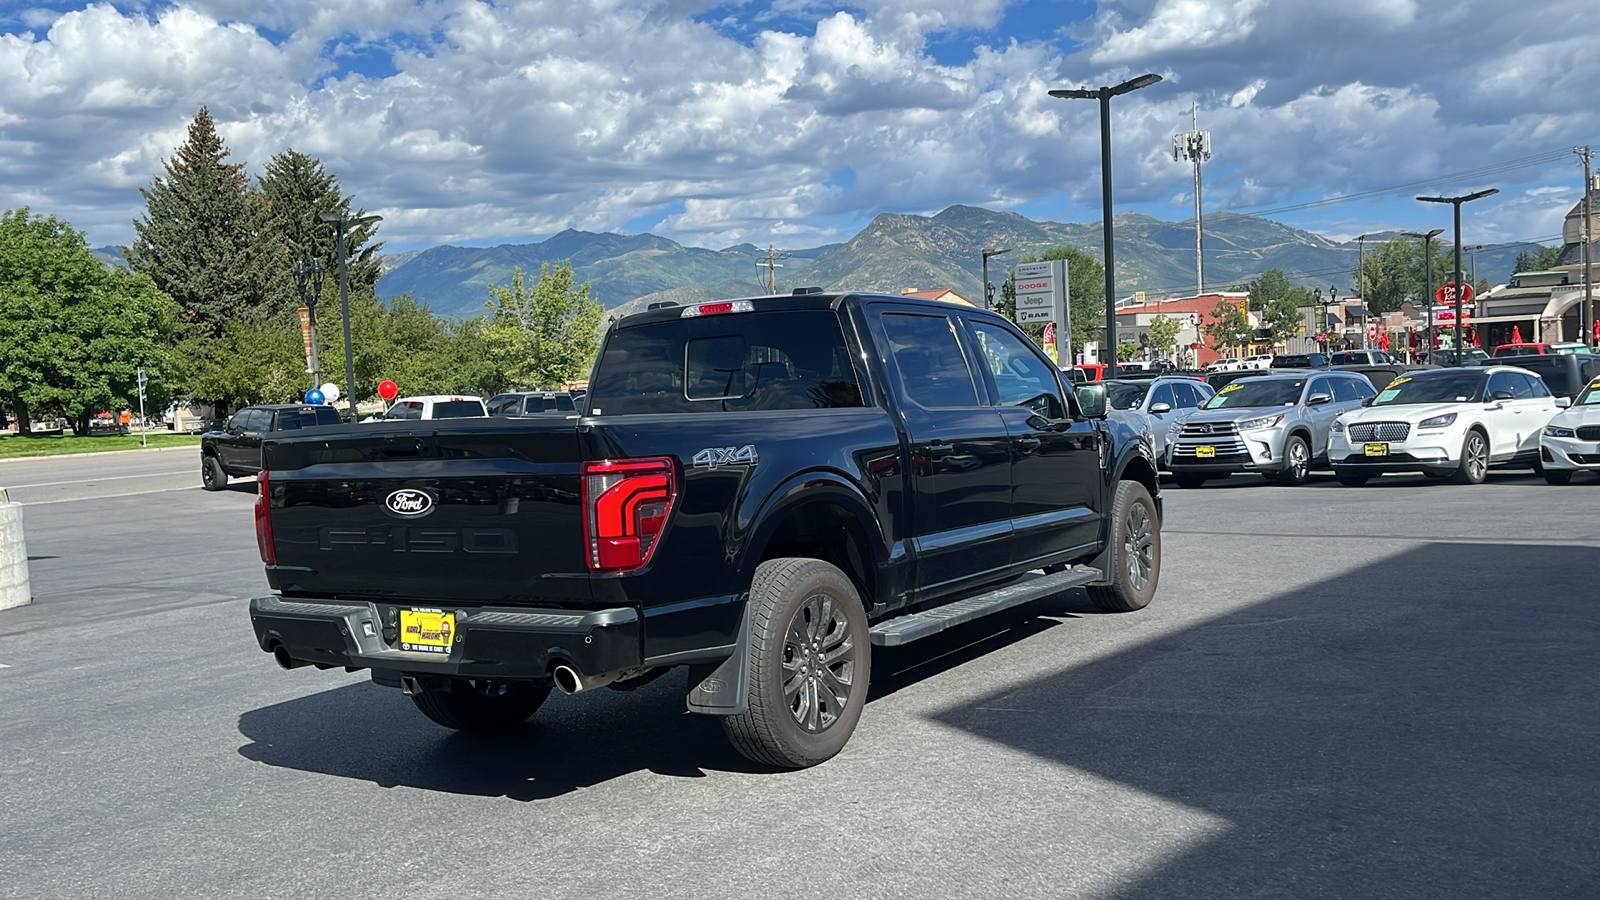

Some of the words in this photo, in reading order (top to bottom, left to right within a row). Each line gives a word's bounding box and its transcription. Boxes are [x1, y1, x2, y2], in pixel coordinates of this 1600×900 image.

[1018, 282, 1048, 290] DODGE
[1444, 285, 1466, 297] Day
[1024, 296, 1043, 305] Jeep
[393, 492, 423, 510] Ford
[319, 527, 519, 553] F-150
